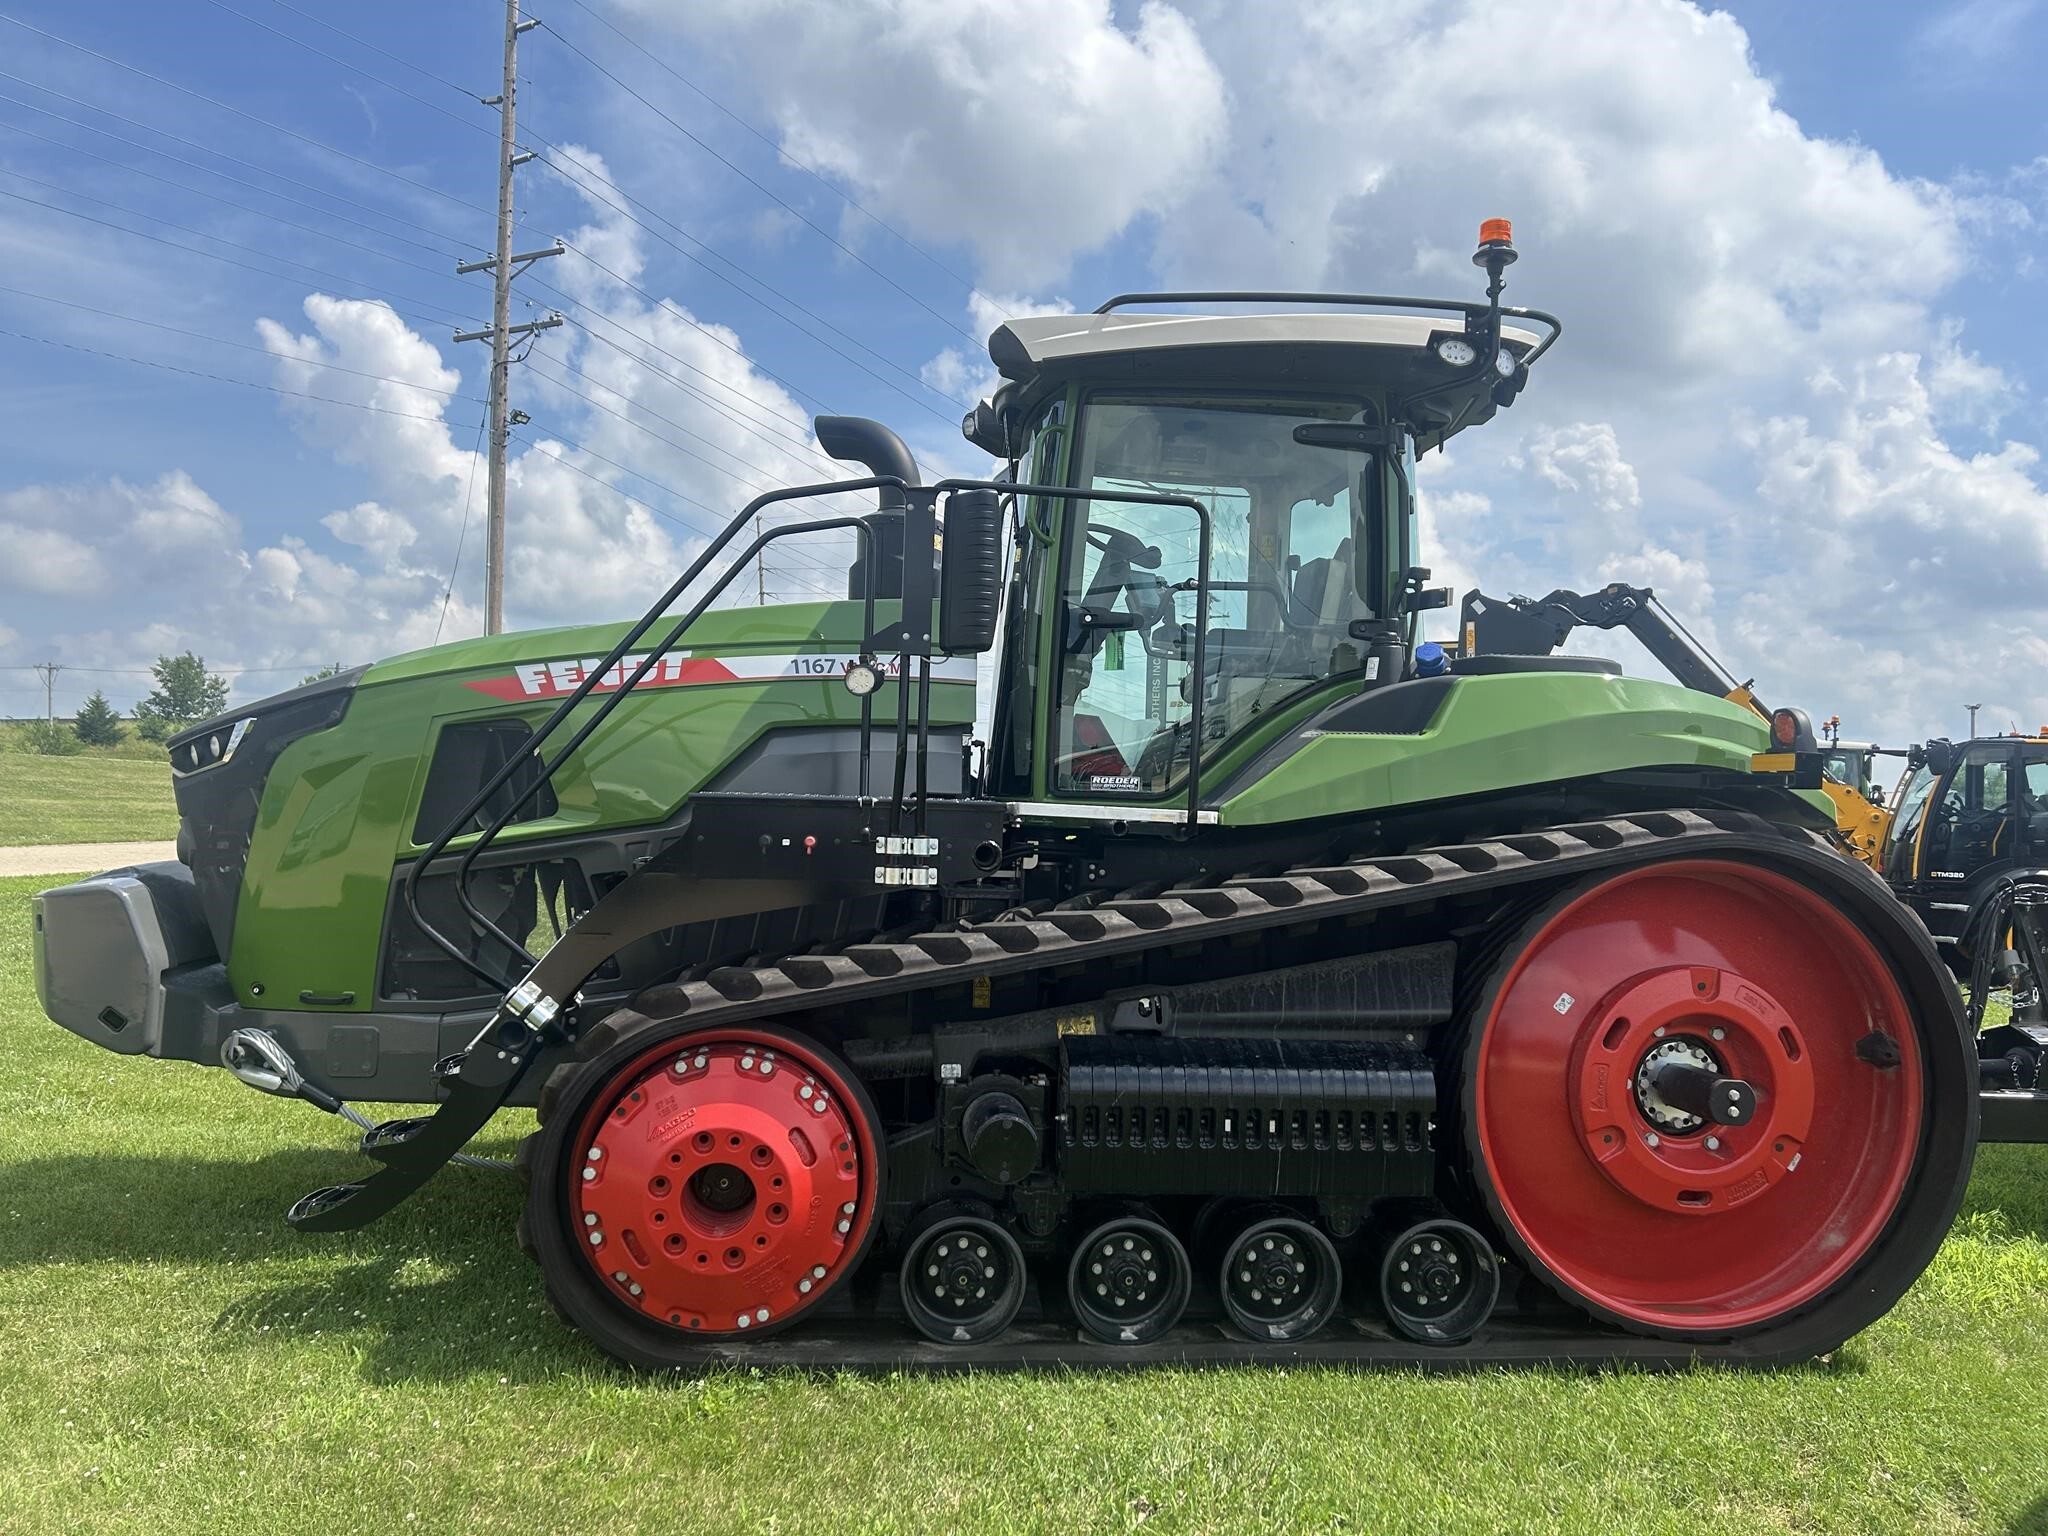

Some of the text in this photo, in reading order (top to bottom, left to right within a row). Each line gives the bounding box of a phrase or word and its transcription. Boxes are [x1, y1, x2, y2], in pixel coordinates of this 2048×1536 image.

[791, 658, 836, 674] 1167
[514, 650, 693, 695] FENDT
[1092, 776, 1138, 785] ROEDER
[1936, 871, 1965, 879] TM320
